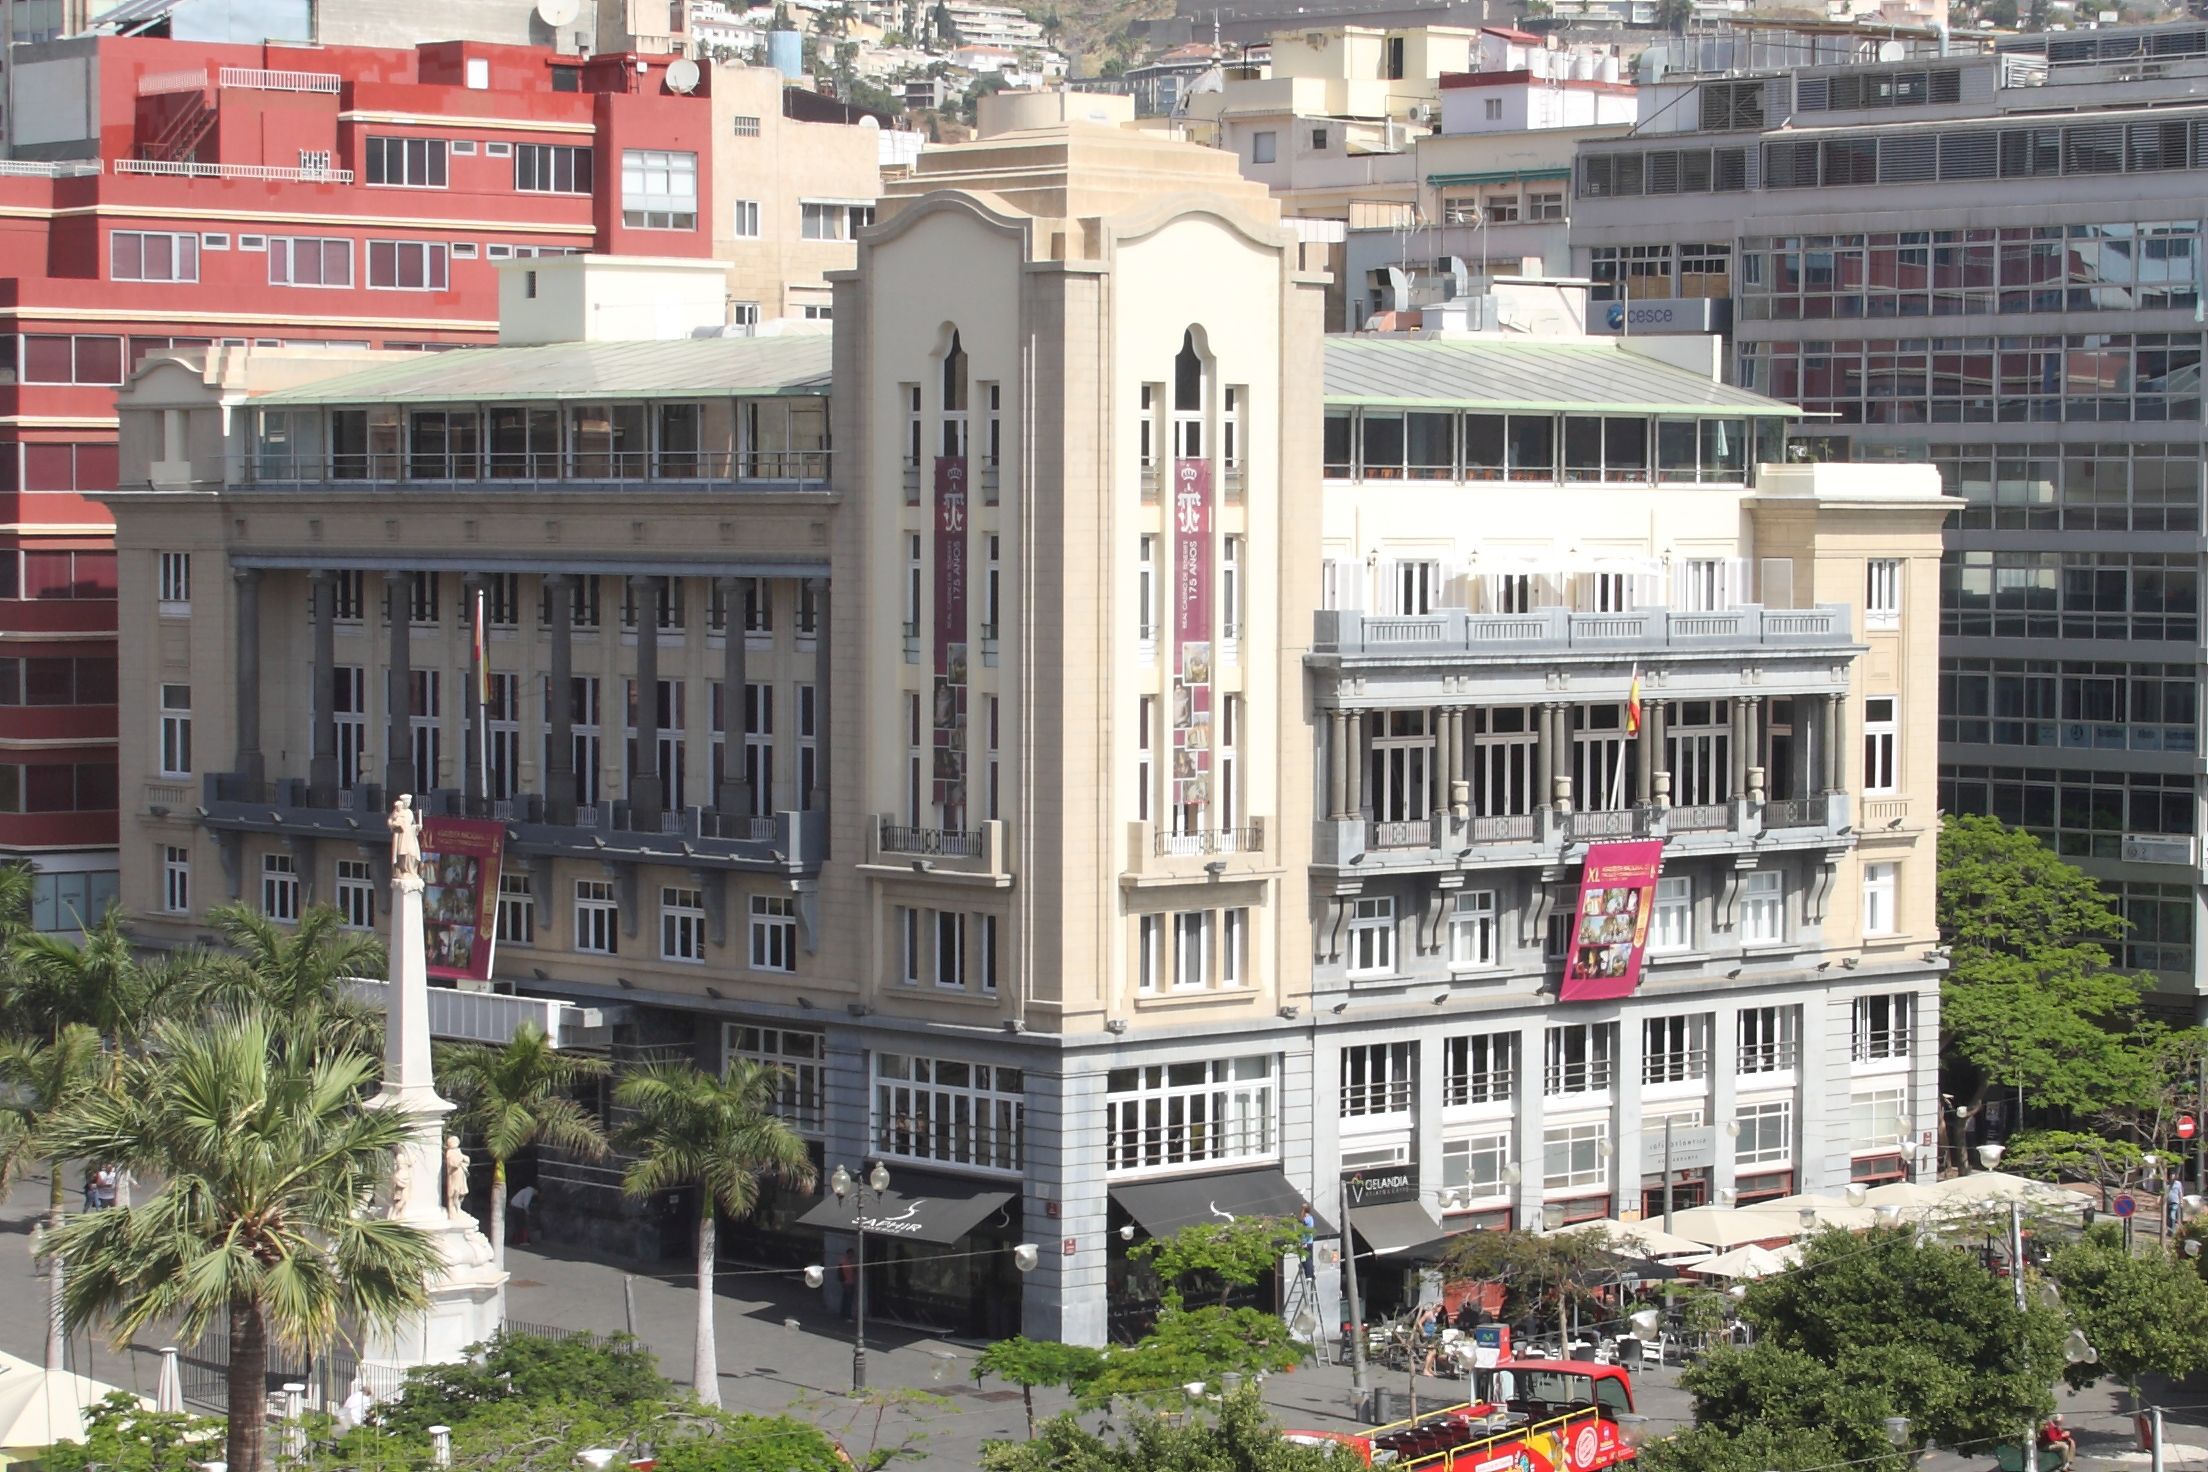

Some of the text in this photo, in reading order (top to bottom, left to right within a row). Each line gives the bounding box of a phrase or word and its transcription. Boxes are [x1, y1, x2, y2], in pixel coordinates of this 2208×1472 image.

[1628, 309, 1673, 323] cesce
[953, 578, 961, 600] 175
[1189, 578, 1198, 600] 175
[1587, 867, 1600, 883] XL
[1365, 1175, 1409, 1191] GELANDIA
[851, 1216, 922, 1232] SAPHIR
